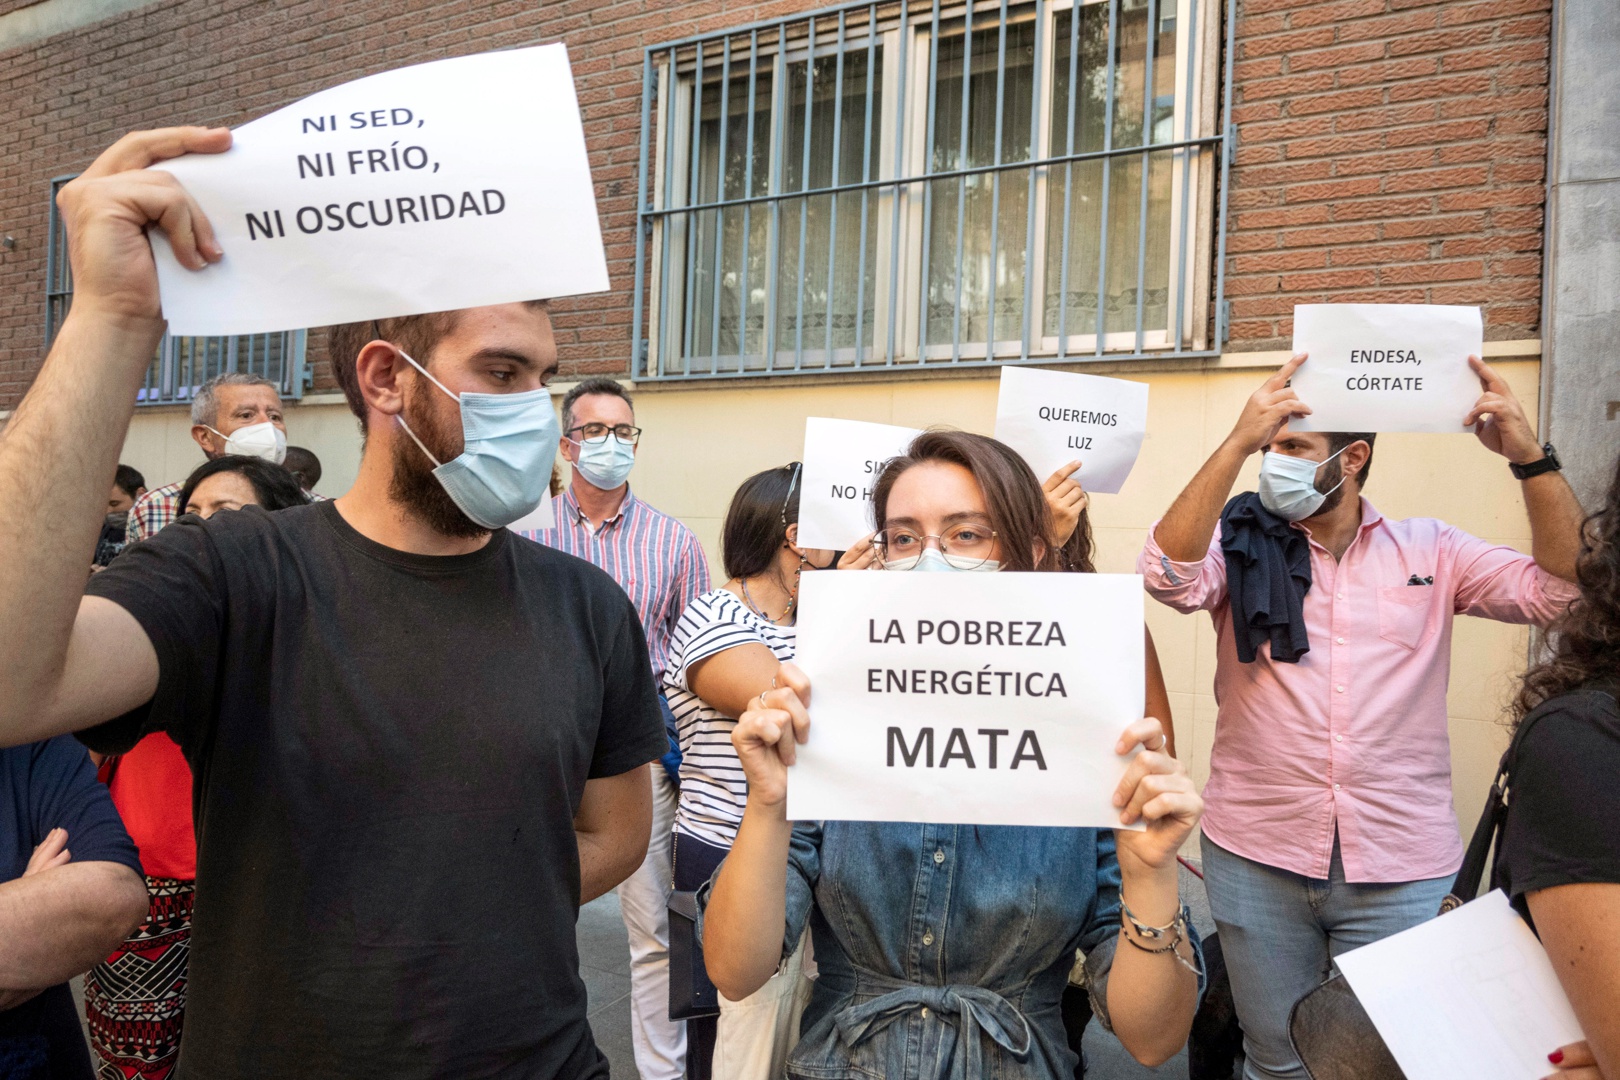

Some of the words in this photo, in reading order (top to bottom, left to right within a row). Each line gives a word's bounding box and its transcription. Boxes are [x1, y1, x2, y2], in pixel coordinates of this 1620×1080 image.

[302, 115, 336, 134] NI
[349, 108, 425, 129] SED,
[297, 152, 335, 179] NI
[347, 140, 440, 175] FRÍO,
[246, 209, 286, 241] NI
[296, 189, 505, 235] OSCURIDAD
[1350, 349, 1423, 366] ENDESA,
[1346, 374, 1423, 391] CÓRTATE
[1038, 406, 1118, 427] QUEREMOS
[1068, 435, 1093, 450] LUZ
[831, 484, 857, 500] NO
[869, 619, 906, 644] LA
[917, 620, 1066, 647] POBREZA
[868, 664, 1067, 698] ENERGÉTICA
[886, 726, 1048, 771] MATA
